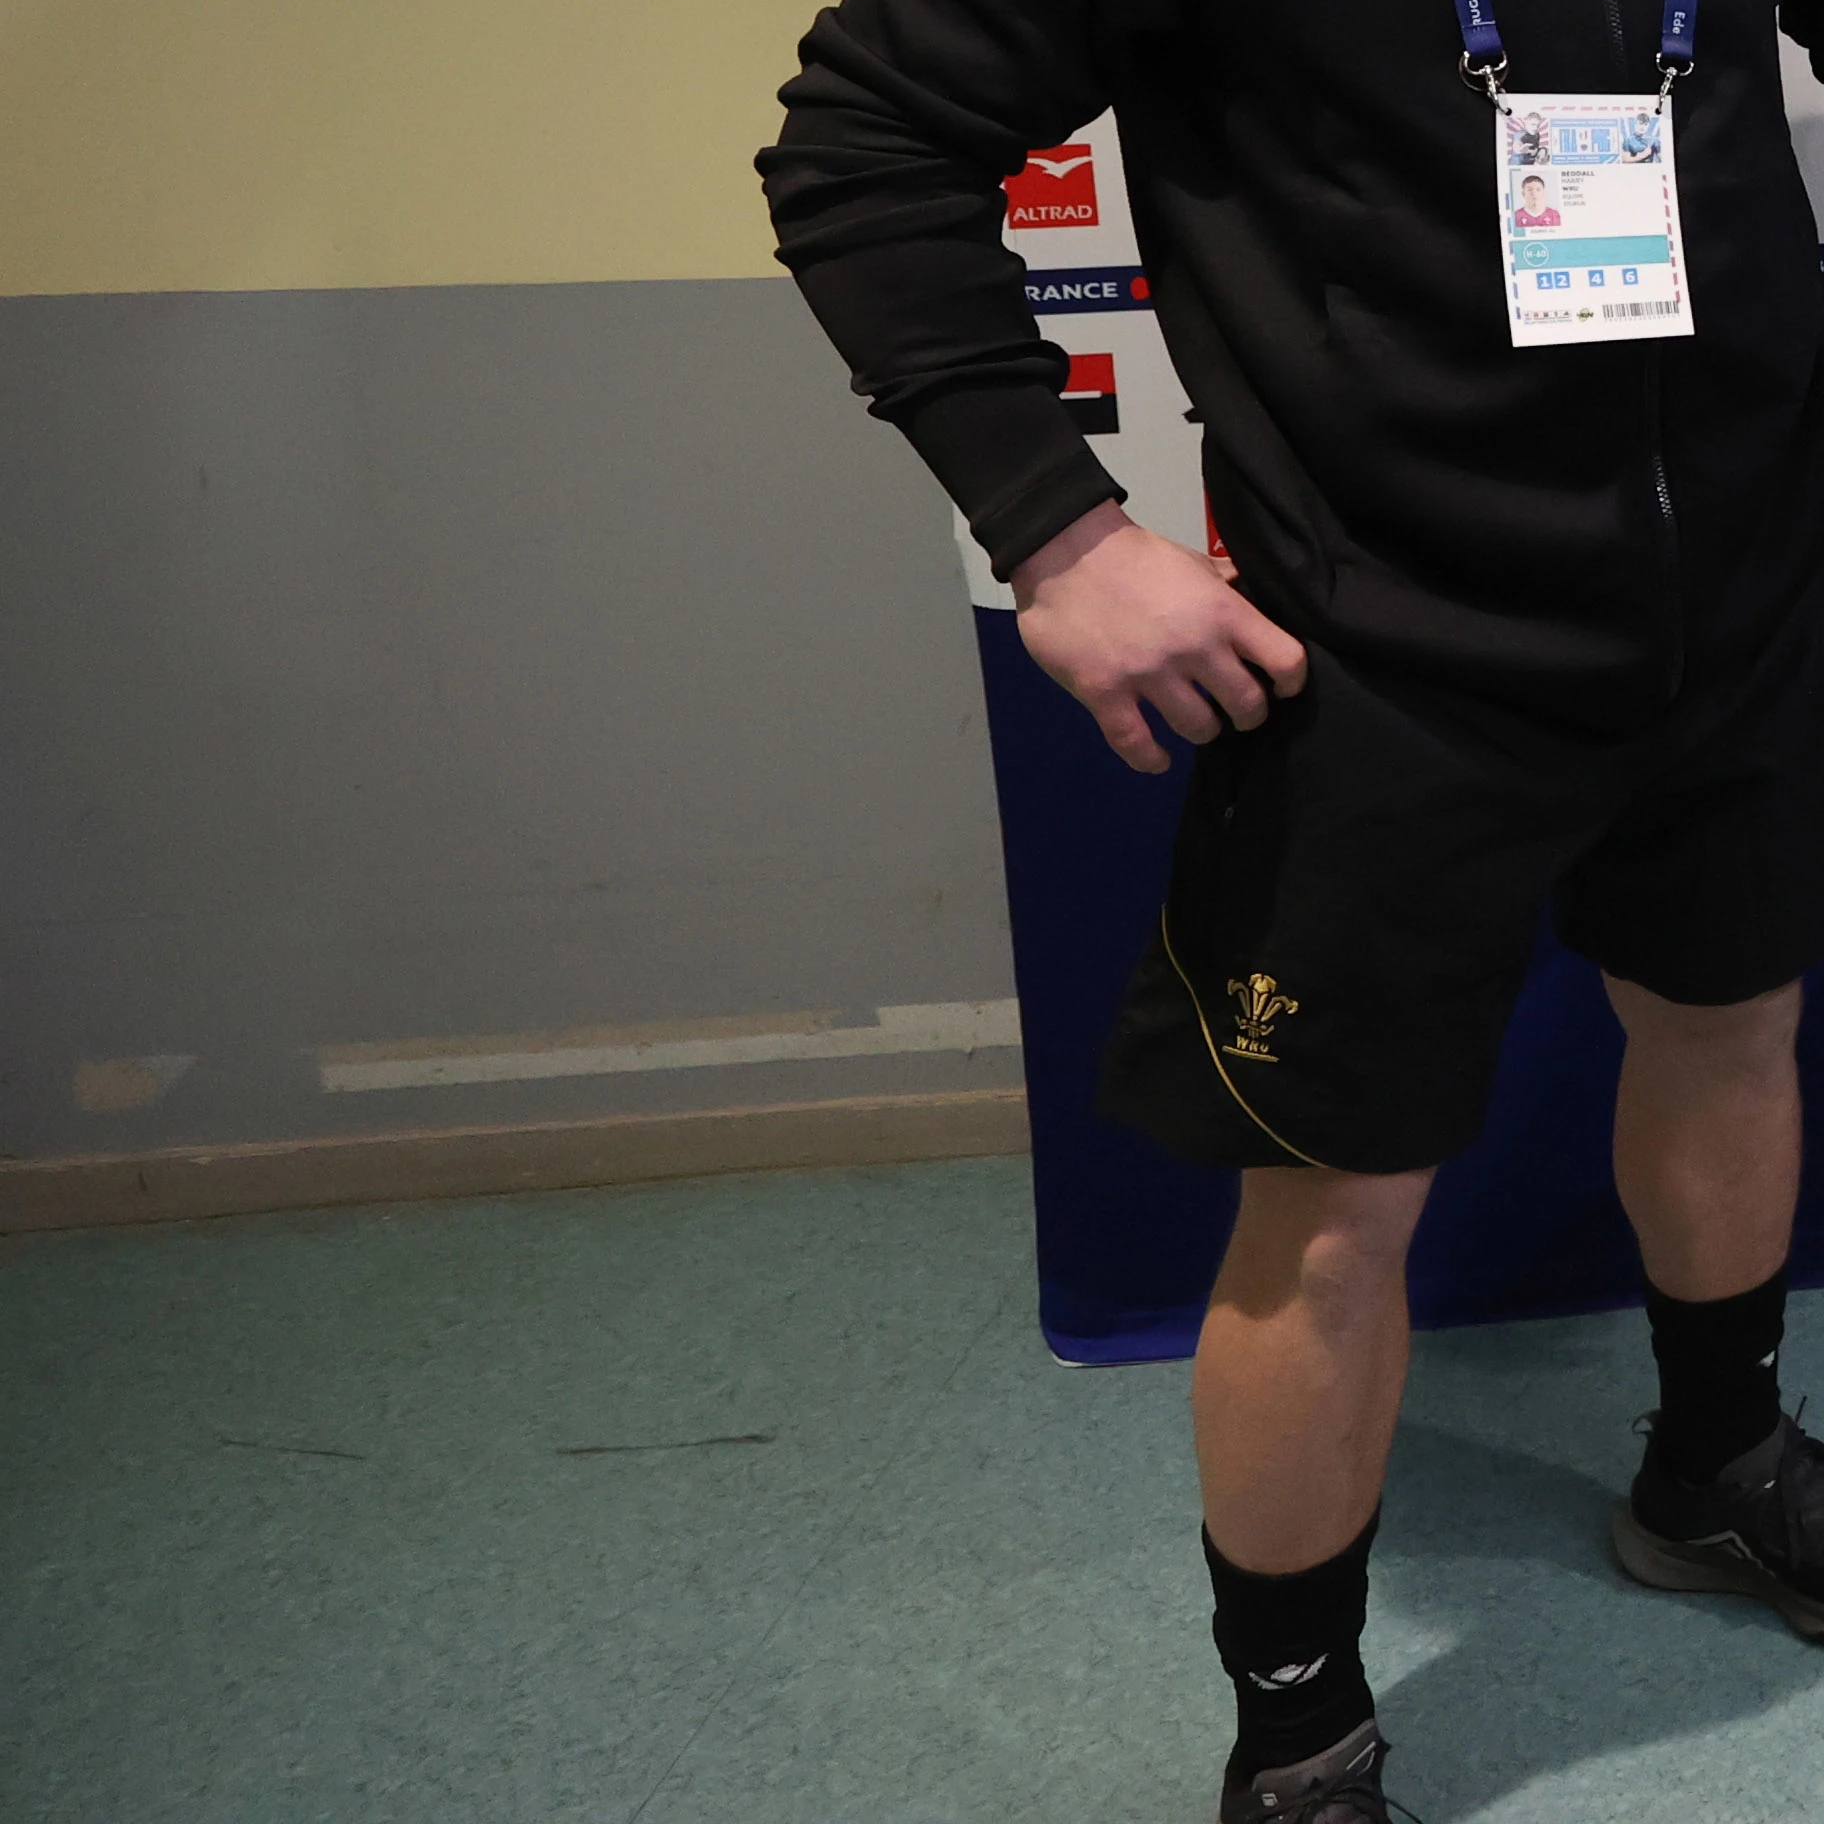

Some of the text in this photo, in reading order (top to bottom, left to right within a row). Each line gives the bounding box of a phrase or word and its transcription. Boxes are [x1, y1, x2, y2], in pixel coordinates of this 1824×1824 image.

[1672, 10, 1686, 35] Ede
[1013, 204, 1093, 222] ALTRAD
[1024, 282, 1119, 302] RANCE
